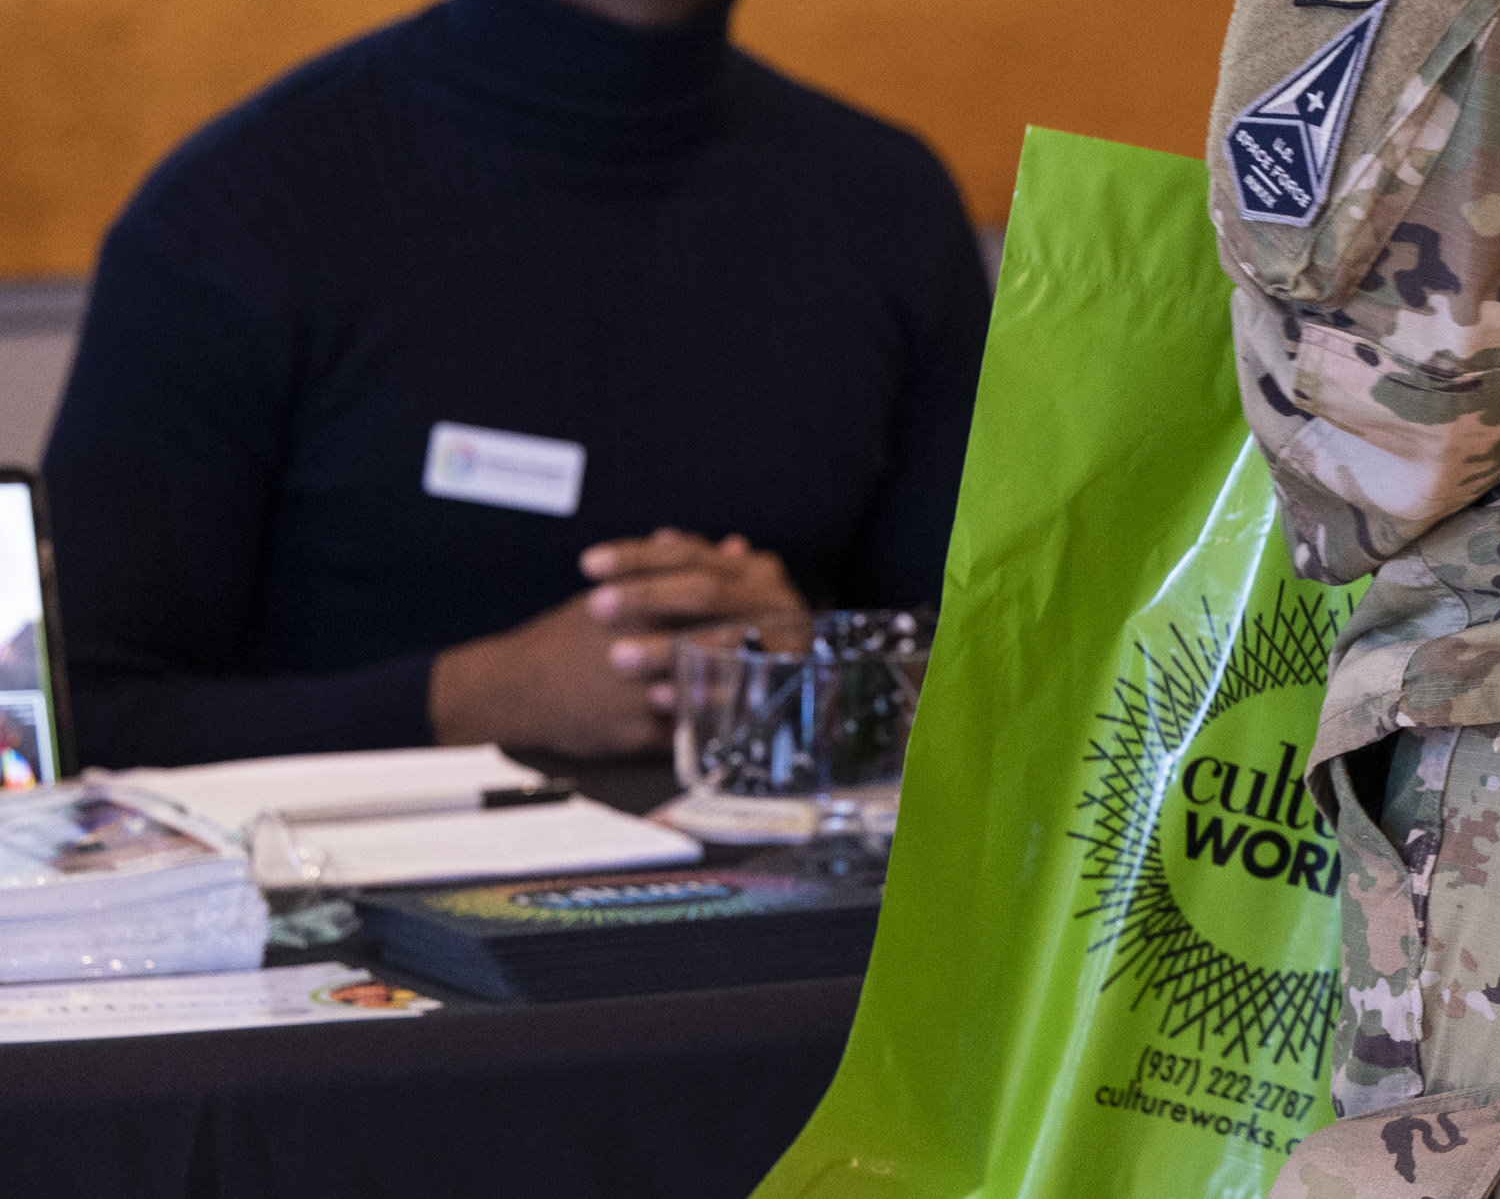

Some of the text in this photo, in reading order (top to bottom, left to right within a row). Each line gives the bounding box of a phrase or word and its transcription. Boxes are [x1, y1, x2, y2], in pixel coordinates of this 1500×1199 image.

[1270, 165, 1312, 208] FORCE
[1135, 1045, 1315, 1121] (937) 222-2787
